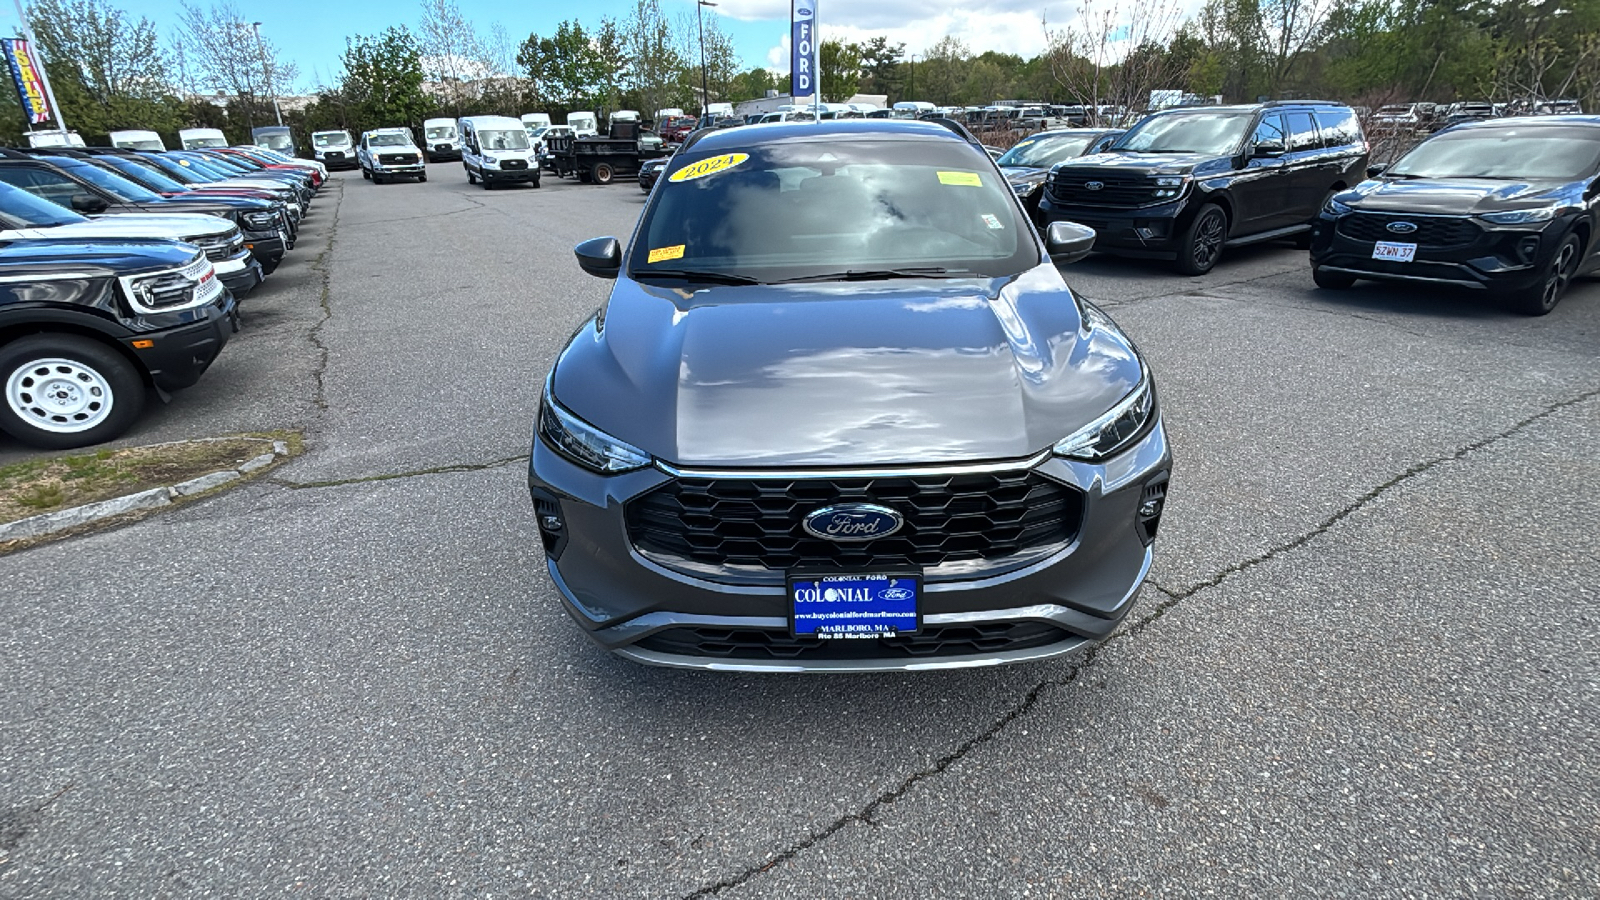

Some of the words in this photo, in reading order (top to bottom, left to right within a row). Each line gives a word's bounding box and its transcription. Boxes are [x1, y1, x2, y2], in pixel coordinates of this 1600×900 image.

[799, 23, 811, 90] FORD
[14, 49, 46, 114] SALE
[683, 155, 735, 179] 2024
[1400, 248, 1413, 258] 37
[826, 512, 881, 535] Ford
[794, 587, 873, 603] COLONIAL
[820, 624, 873, 633] MARLBORO,
[874, 624, 889, 632] MA
[844, 632, 879, 640] Marlboro
[883, 631, 896, 639] MA
